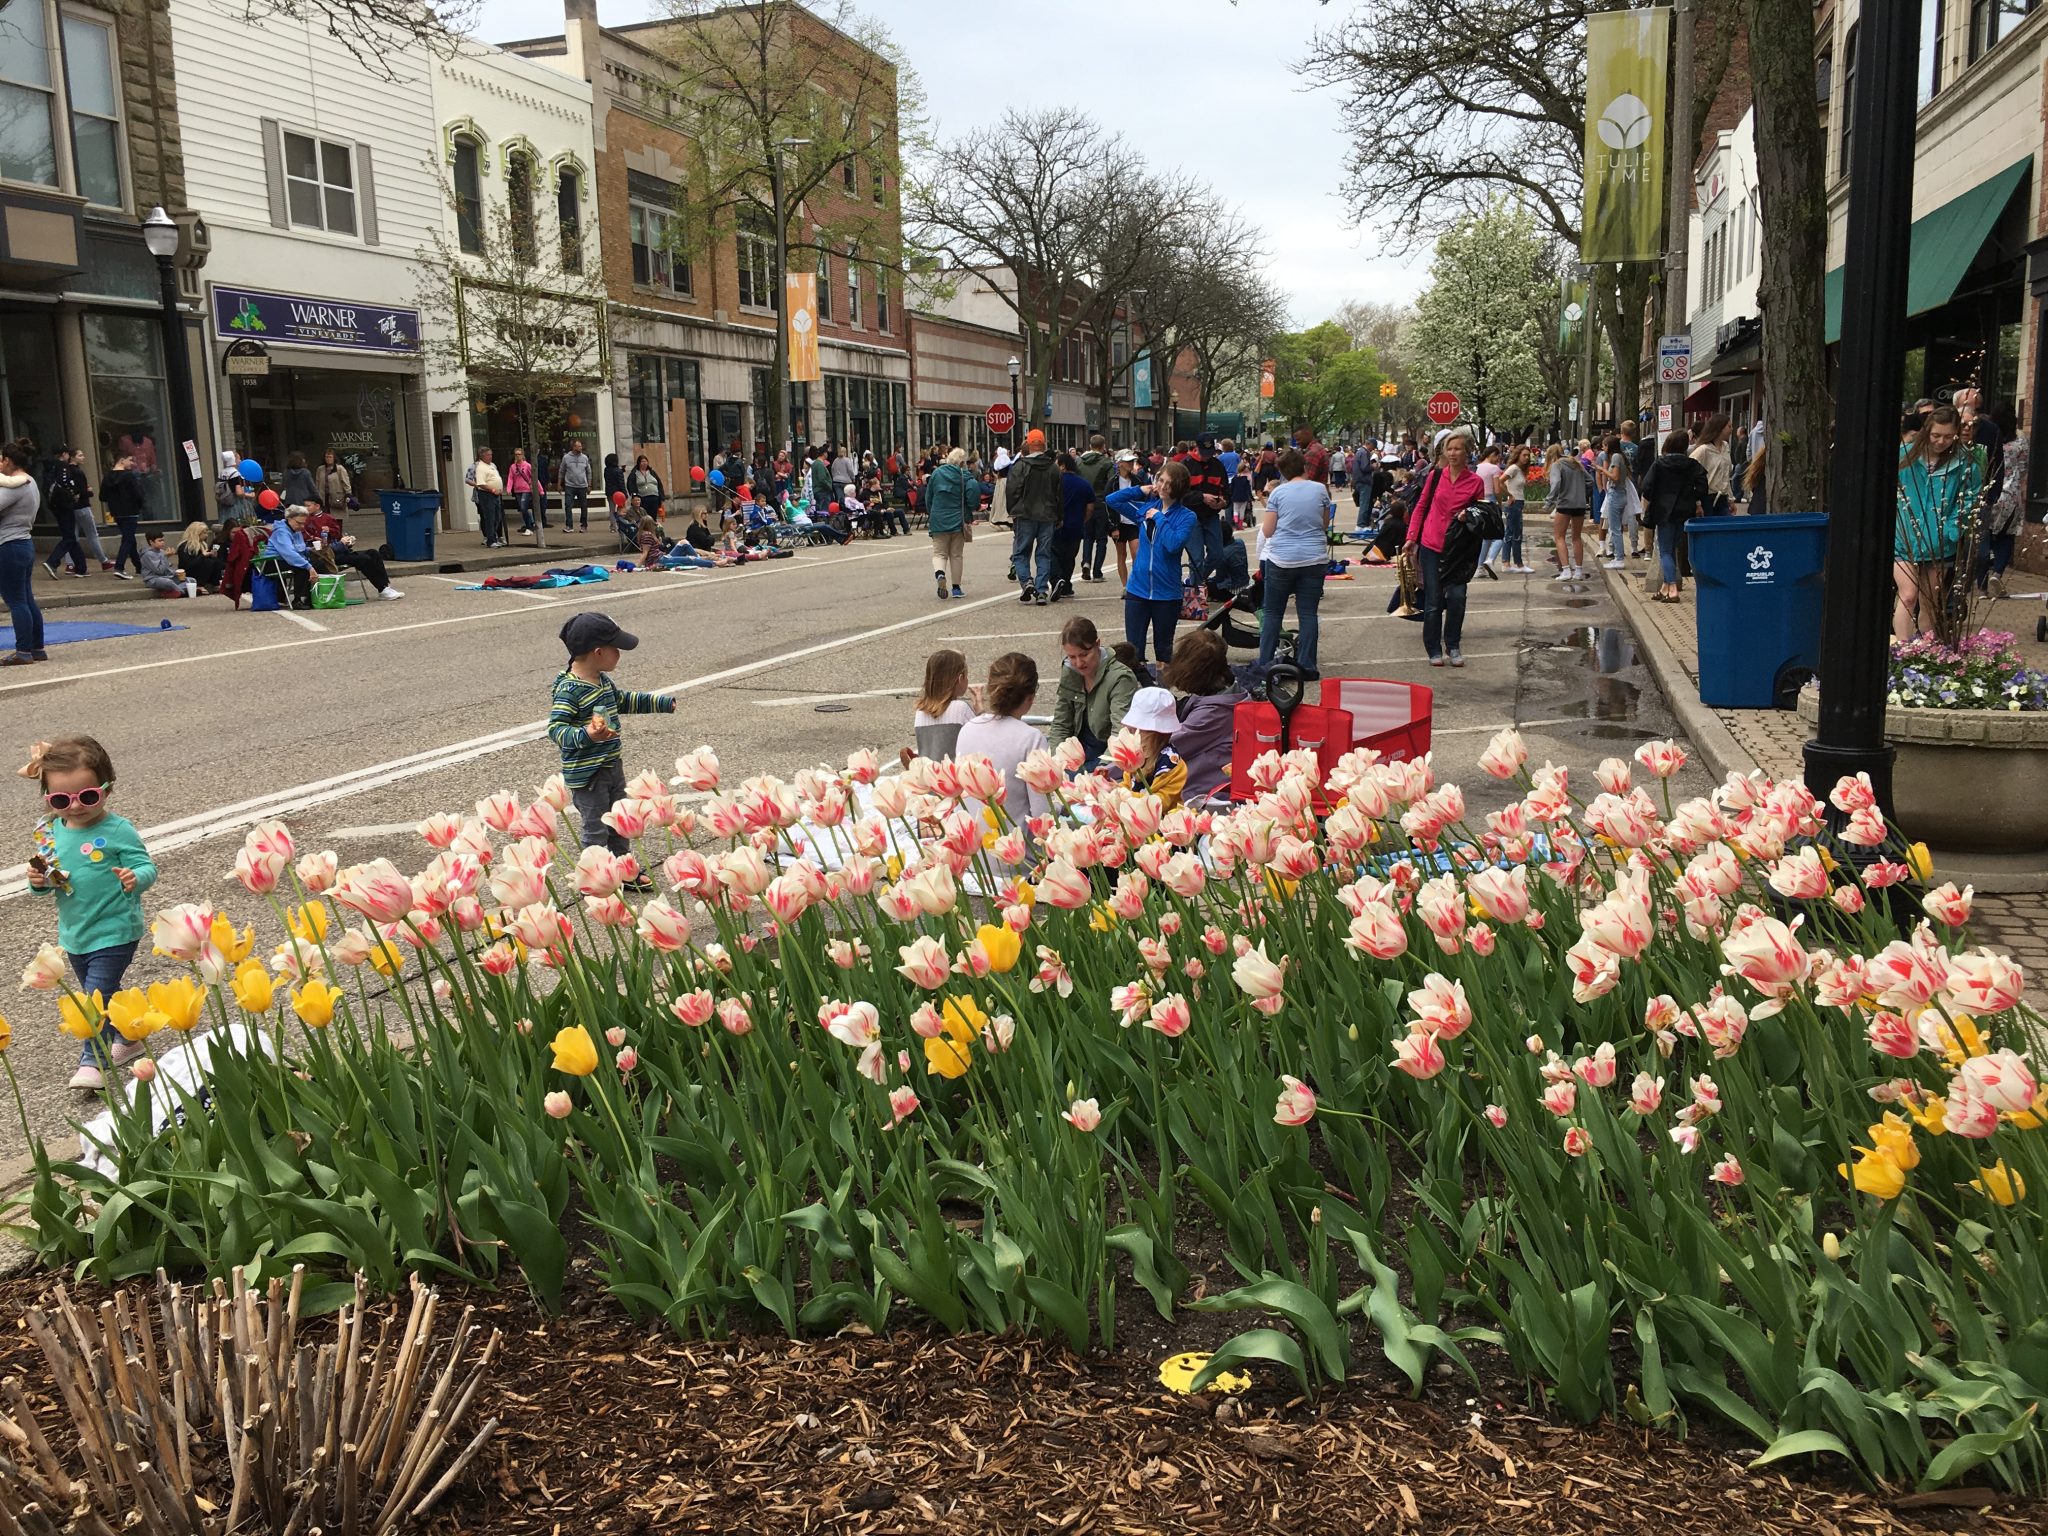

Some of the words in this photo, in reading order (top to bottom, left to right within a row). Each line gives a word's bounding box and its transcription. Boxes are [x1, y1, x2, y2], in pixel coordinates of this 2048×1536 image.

[1596, 151, 1651, 168] TULIP
[1596, 167, 1650, 184] TIME
[290, 303, 358, 329] WARNER
[299, 328, 354, 339] VINEYARDS
[230, 357, 266, 366] WARNER
[1429, 401, 1459, 415] STOP
[1660, 409, 1670, 418] NO
[988, 412, 1013, 424] STOP
[330, 431, 374, 442] WARNER
